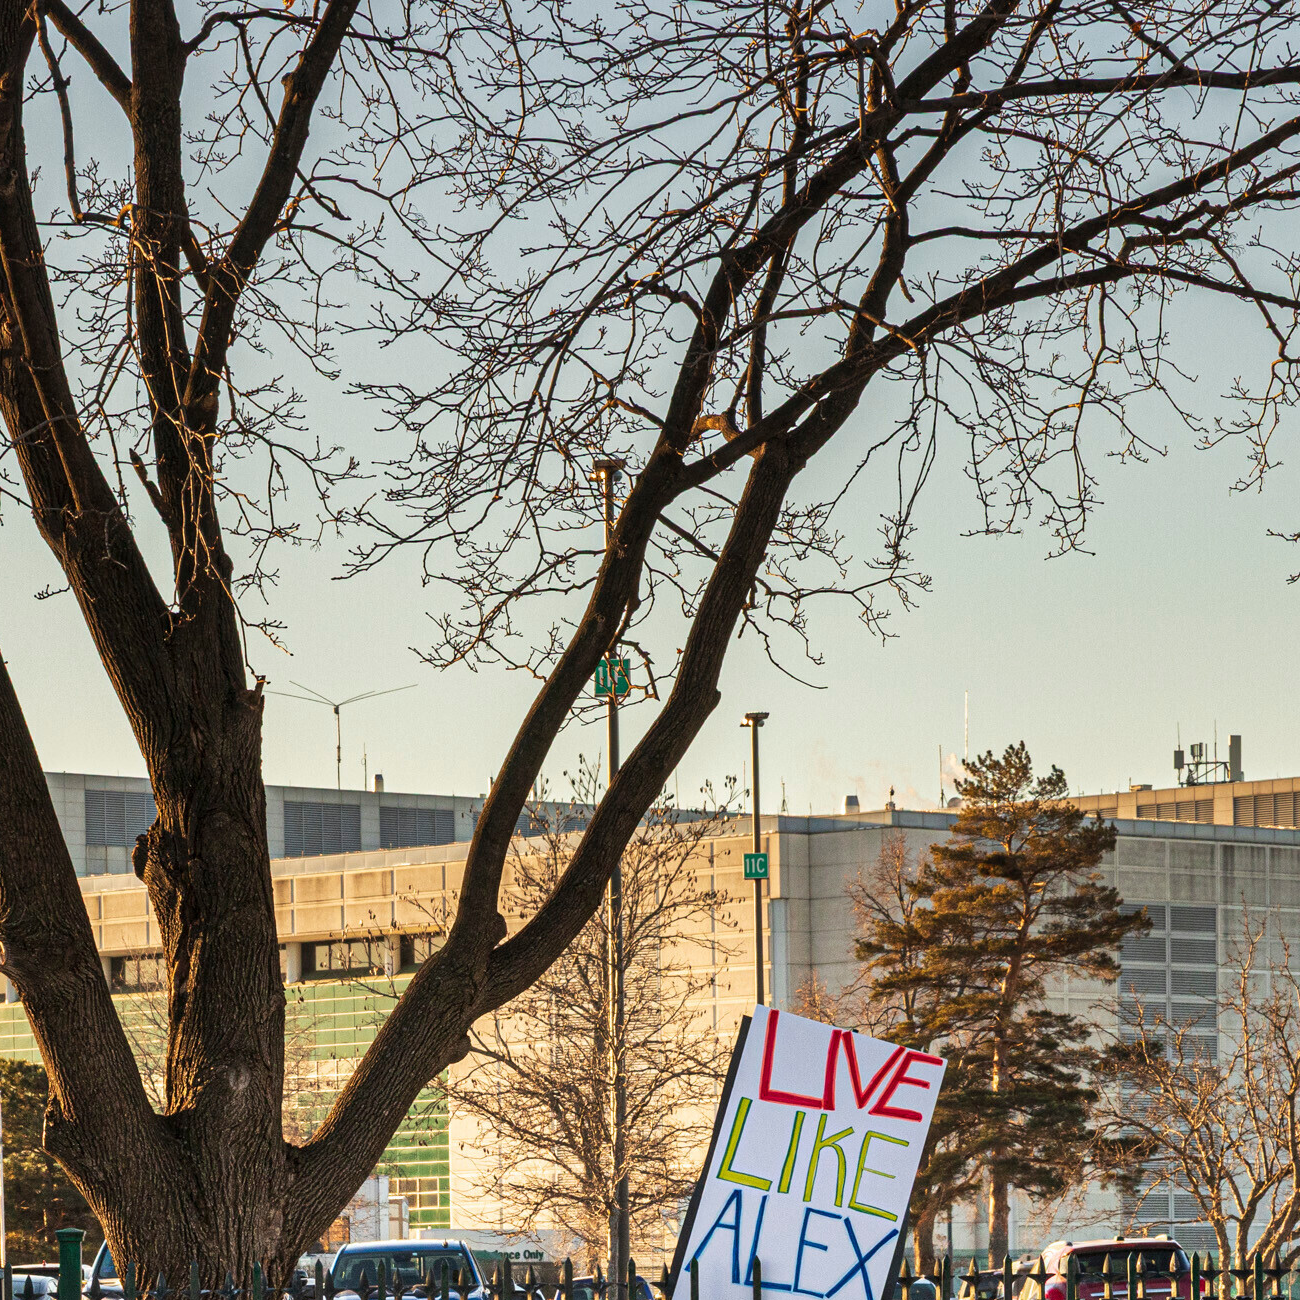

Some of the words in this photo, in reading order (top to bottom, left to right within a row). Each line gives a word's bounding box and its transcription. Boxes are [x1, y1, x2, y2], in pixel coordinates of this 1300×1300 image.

[745, 857, 765, 874] 11C
[759, 1009, 944, 1123] LIVE
[717, 1097, 909, 1223] LIKE
[523, 1249, 544, 1261] Only
